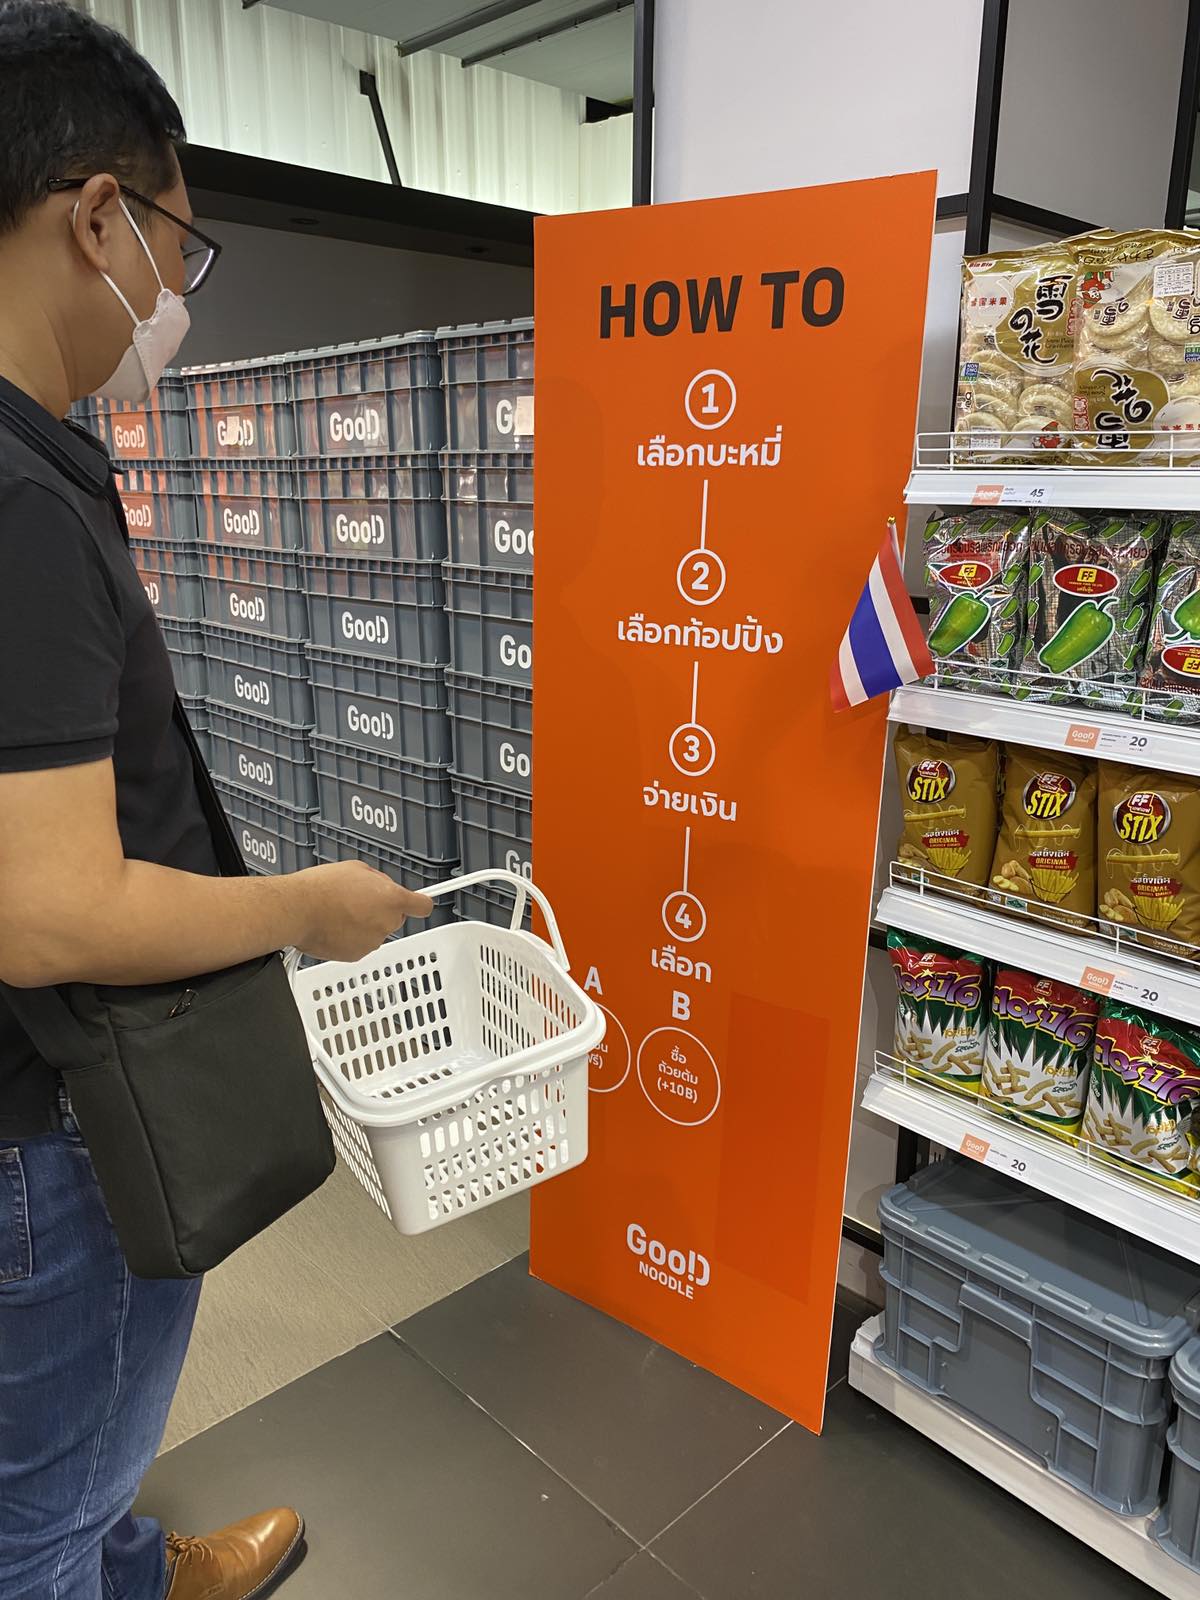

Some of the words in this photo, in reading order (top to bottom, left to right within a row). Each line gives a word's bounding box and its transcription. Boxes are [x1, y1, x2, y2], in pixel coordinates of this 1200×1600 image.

[600, 275, 742, 339] HOW
[760, 267, 845, 329] TO
[701, 383, 719, 414] 1
[637, 424, 782, 467] เลือกบะหมี่
[1030, 488, 1044, 497] 45
[692, 561, 709, 591] 2
[1081, 572, 1094, 580] FF
[617, 612, 783, 655] เลือกท้อปปิ้ง
[682, 735, 700, 763] 3
[1129, 736, 1147, 747] 20
[921, 761, 938, 771] FF
[642, 780, 737, 822] จ่ายเงิน
[911, 777, 949, 801] STIX
[1132, 794, 1150, 805] FF
[1026, 790, 1067, 817] STIX
[1120, 813, 1163, 842] STIX
[674, 903, 692, 929] 4
[651, 945, 712, 983] เลือก
[584, 966, 603, 995] A
[672, 991, 691, 1021] B
[1141, 989, 1158, 1002] 20
[671, 1046, 687, 1064] ซื้อ
[657, 1077, 698, 1104] (+10B)
[1011, 1159, 1026, 1172] 20
[639, 1261, 694, 1300] NOODLE
